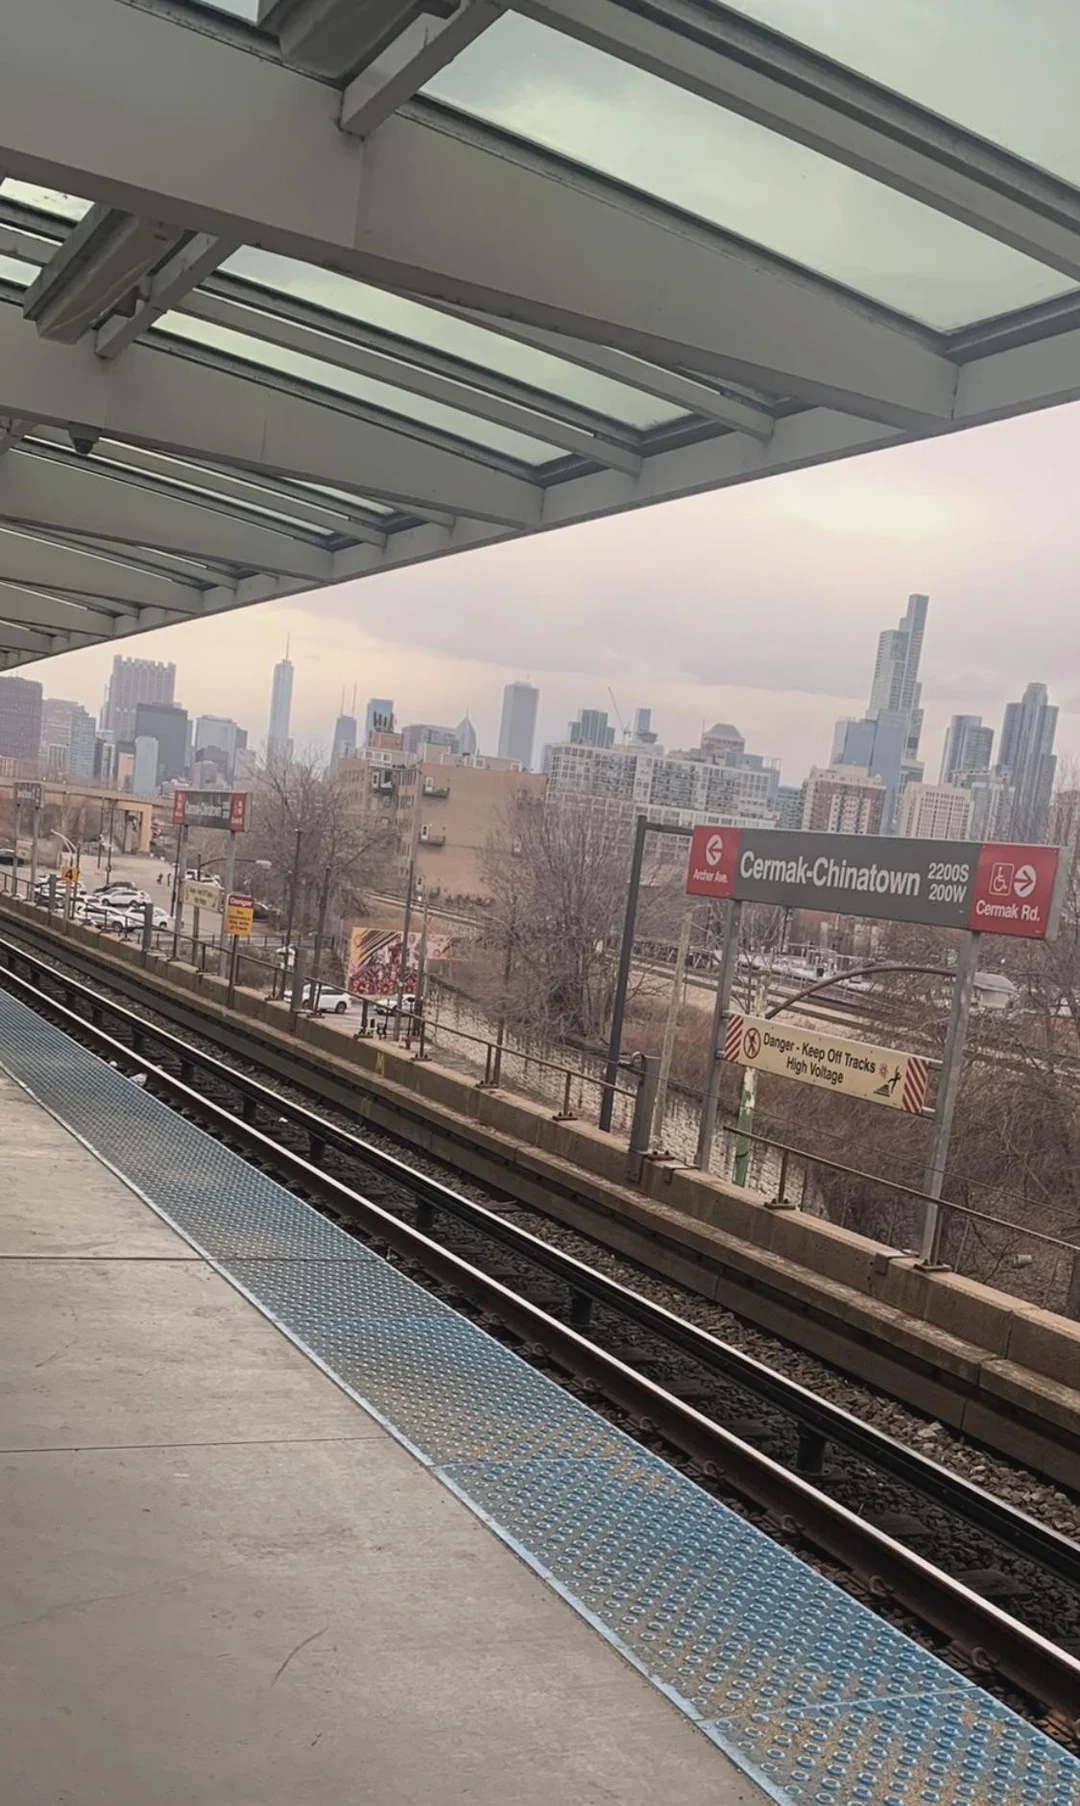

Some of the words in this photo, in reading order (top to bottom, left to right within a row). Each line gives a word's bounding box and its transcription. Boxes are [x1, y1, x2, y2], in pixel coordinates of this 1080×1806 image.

[65, 869, 74, 880] 4
[693, 868, 714, 881] Archer
[714, 871, 729, 884] Ave.
[740, 850, 921, 896] Cermak-Chinatown
[927, 862, 969, 883] 2200S
[928, 883, 967, 904] 200W
[976, 899, 1018, 919] Cermak
[1020, 904, 1041, 922] Rd.
[763, 1032, 796, 1053] Danger
[802, 1042, 825, 1062] Keep
[828, 1048, 844, 1062] Off
[844, 1053, 876, 1074] Tracks
[786, 1056, 808, 1076] High
[809, 1062, 844, 1084] Voltage
